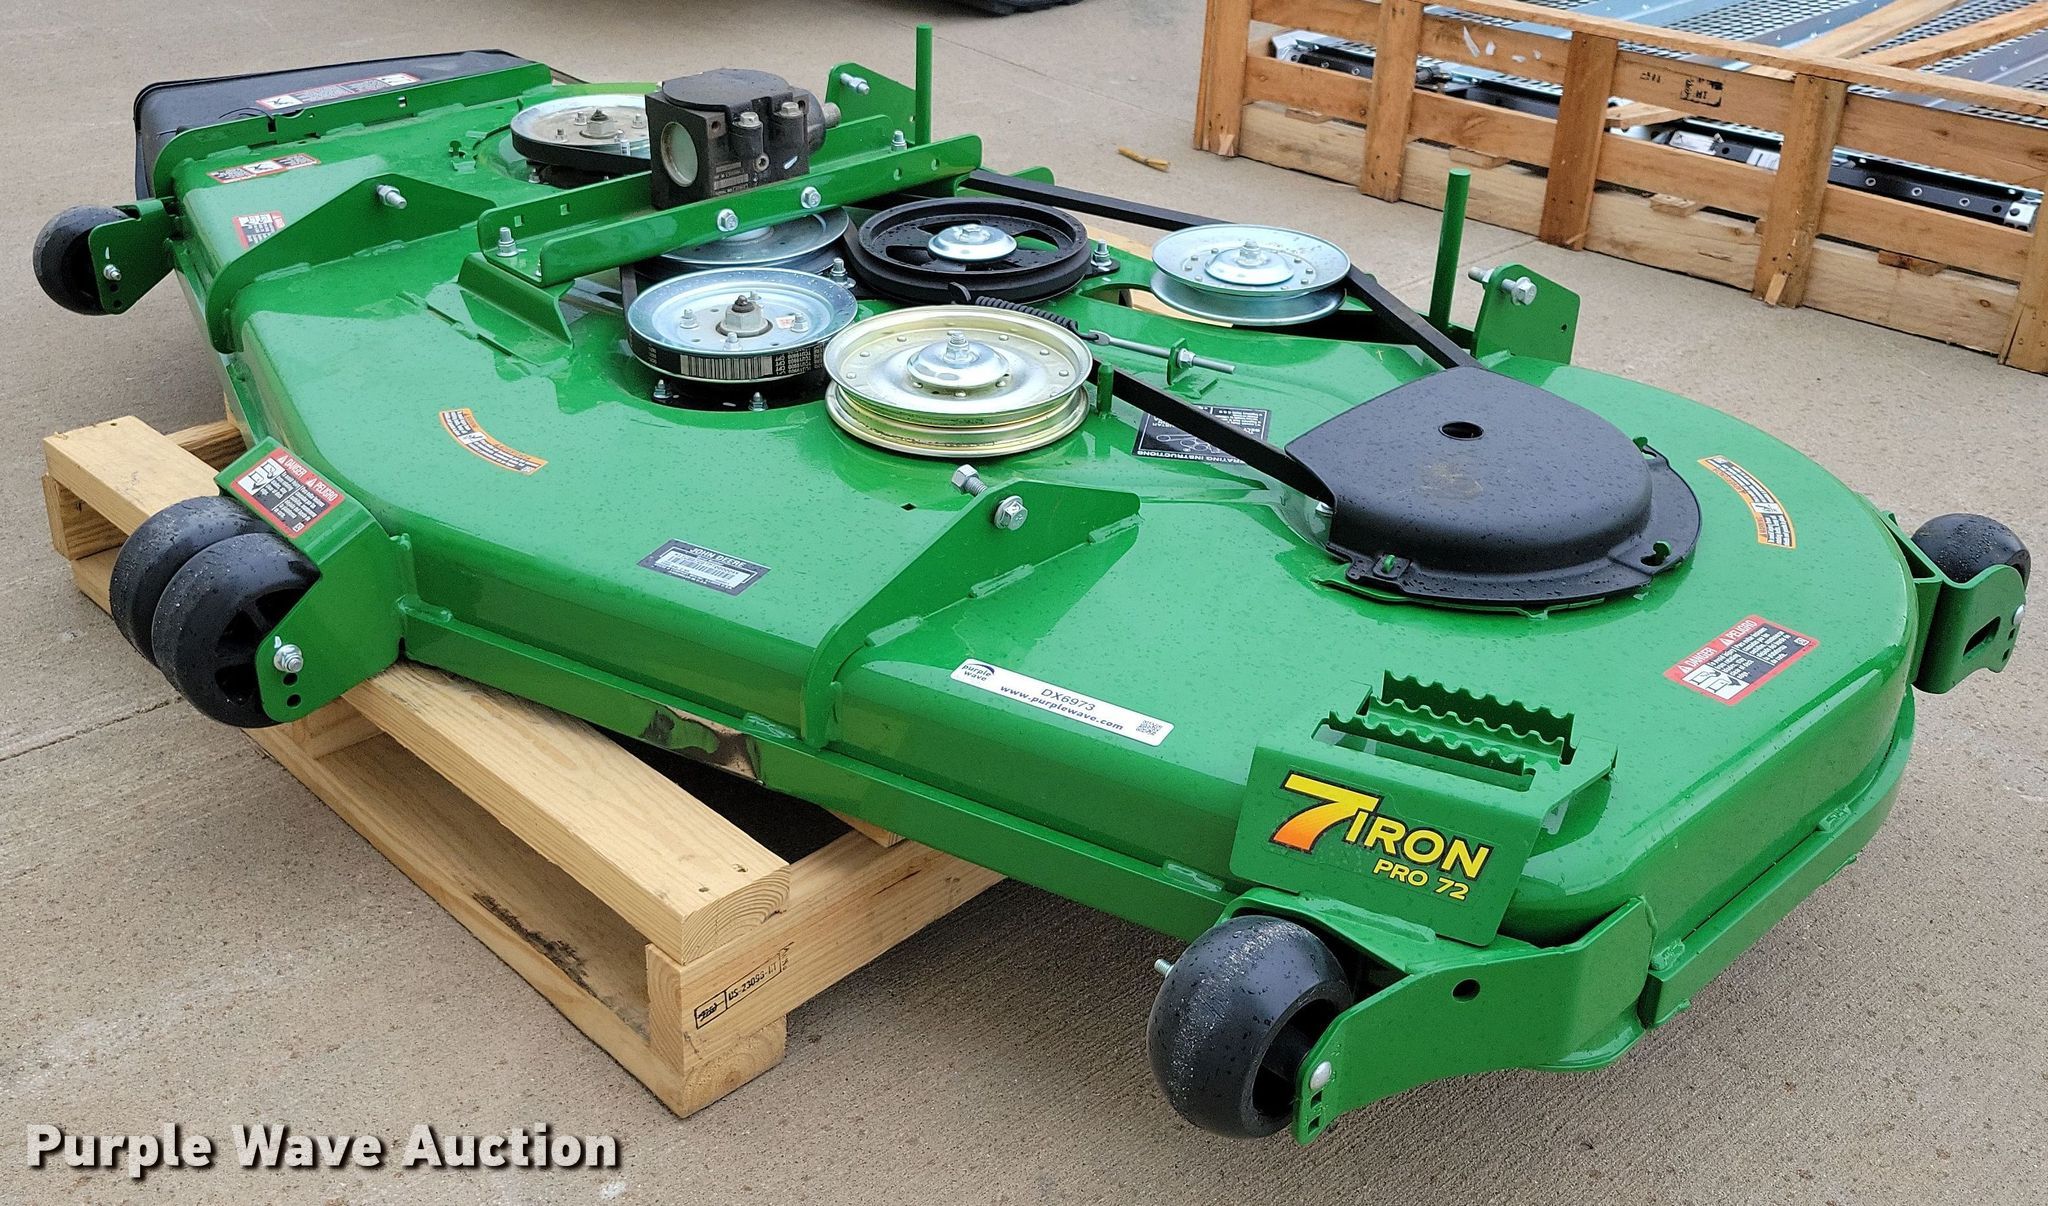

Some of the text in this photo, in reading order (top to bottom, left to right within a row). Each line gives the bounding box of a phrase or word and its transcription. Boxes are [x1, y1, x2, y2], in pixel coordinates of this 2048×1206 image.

[284, 458, 308, 478] DANGER
[1137, 450, 1245, 465] RATING INSTRUCTIONS
[690, 547, 746, 567] JOHN DEERE
[1686, 647, 1717, 666] DANGER
[1728, 620, 1757, 640] PELIGRO
[961, 663, 992, 677] purple
[964, 670, 987, 682] wave
[1000, 684, 1124, 731] www.purplewave.com
[1040, 687, 1096, 712] DX6973
[1269, 769, 1494, 881] 7 IRON
[1373, 858, 1470, 901] PRO 72
